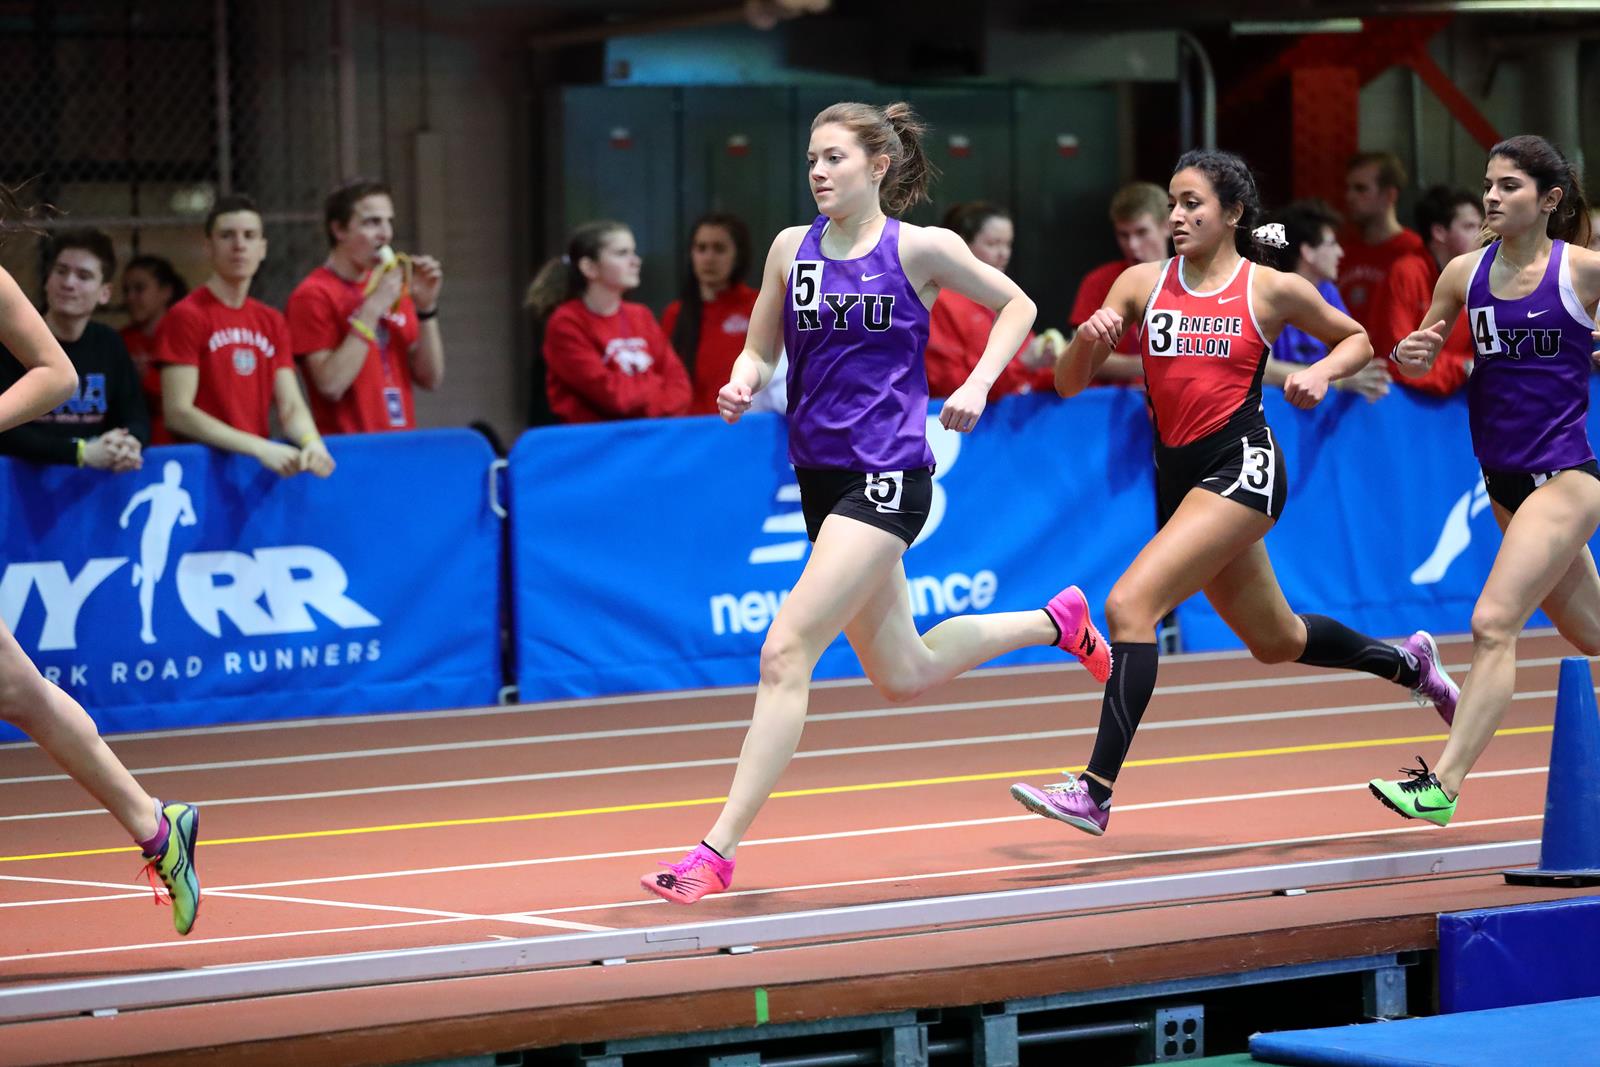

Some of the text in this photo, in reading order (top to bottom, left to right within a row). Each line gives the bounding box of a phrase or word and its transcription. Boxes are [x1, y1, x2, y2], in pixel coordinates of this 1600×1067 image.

[794, 263, 817, 307] 5
[1151, 312, 1174, 353] 3
[1179, 316, 1243, 336] RNEGIE
[1476, 310, 1495, 351] 4
[1497, 328, 1562, 359] YU
[1177, 337, 1231, 358] ELLON
[870, 473, 897, 504] 5
[1246, 450, 1270, 490] 3
[907, 569, 998, 616] nce
[45, 639, 382, 687] RK ROAD RUNNERS
